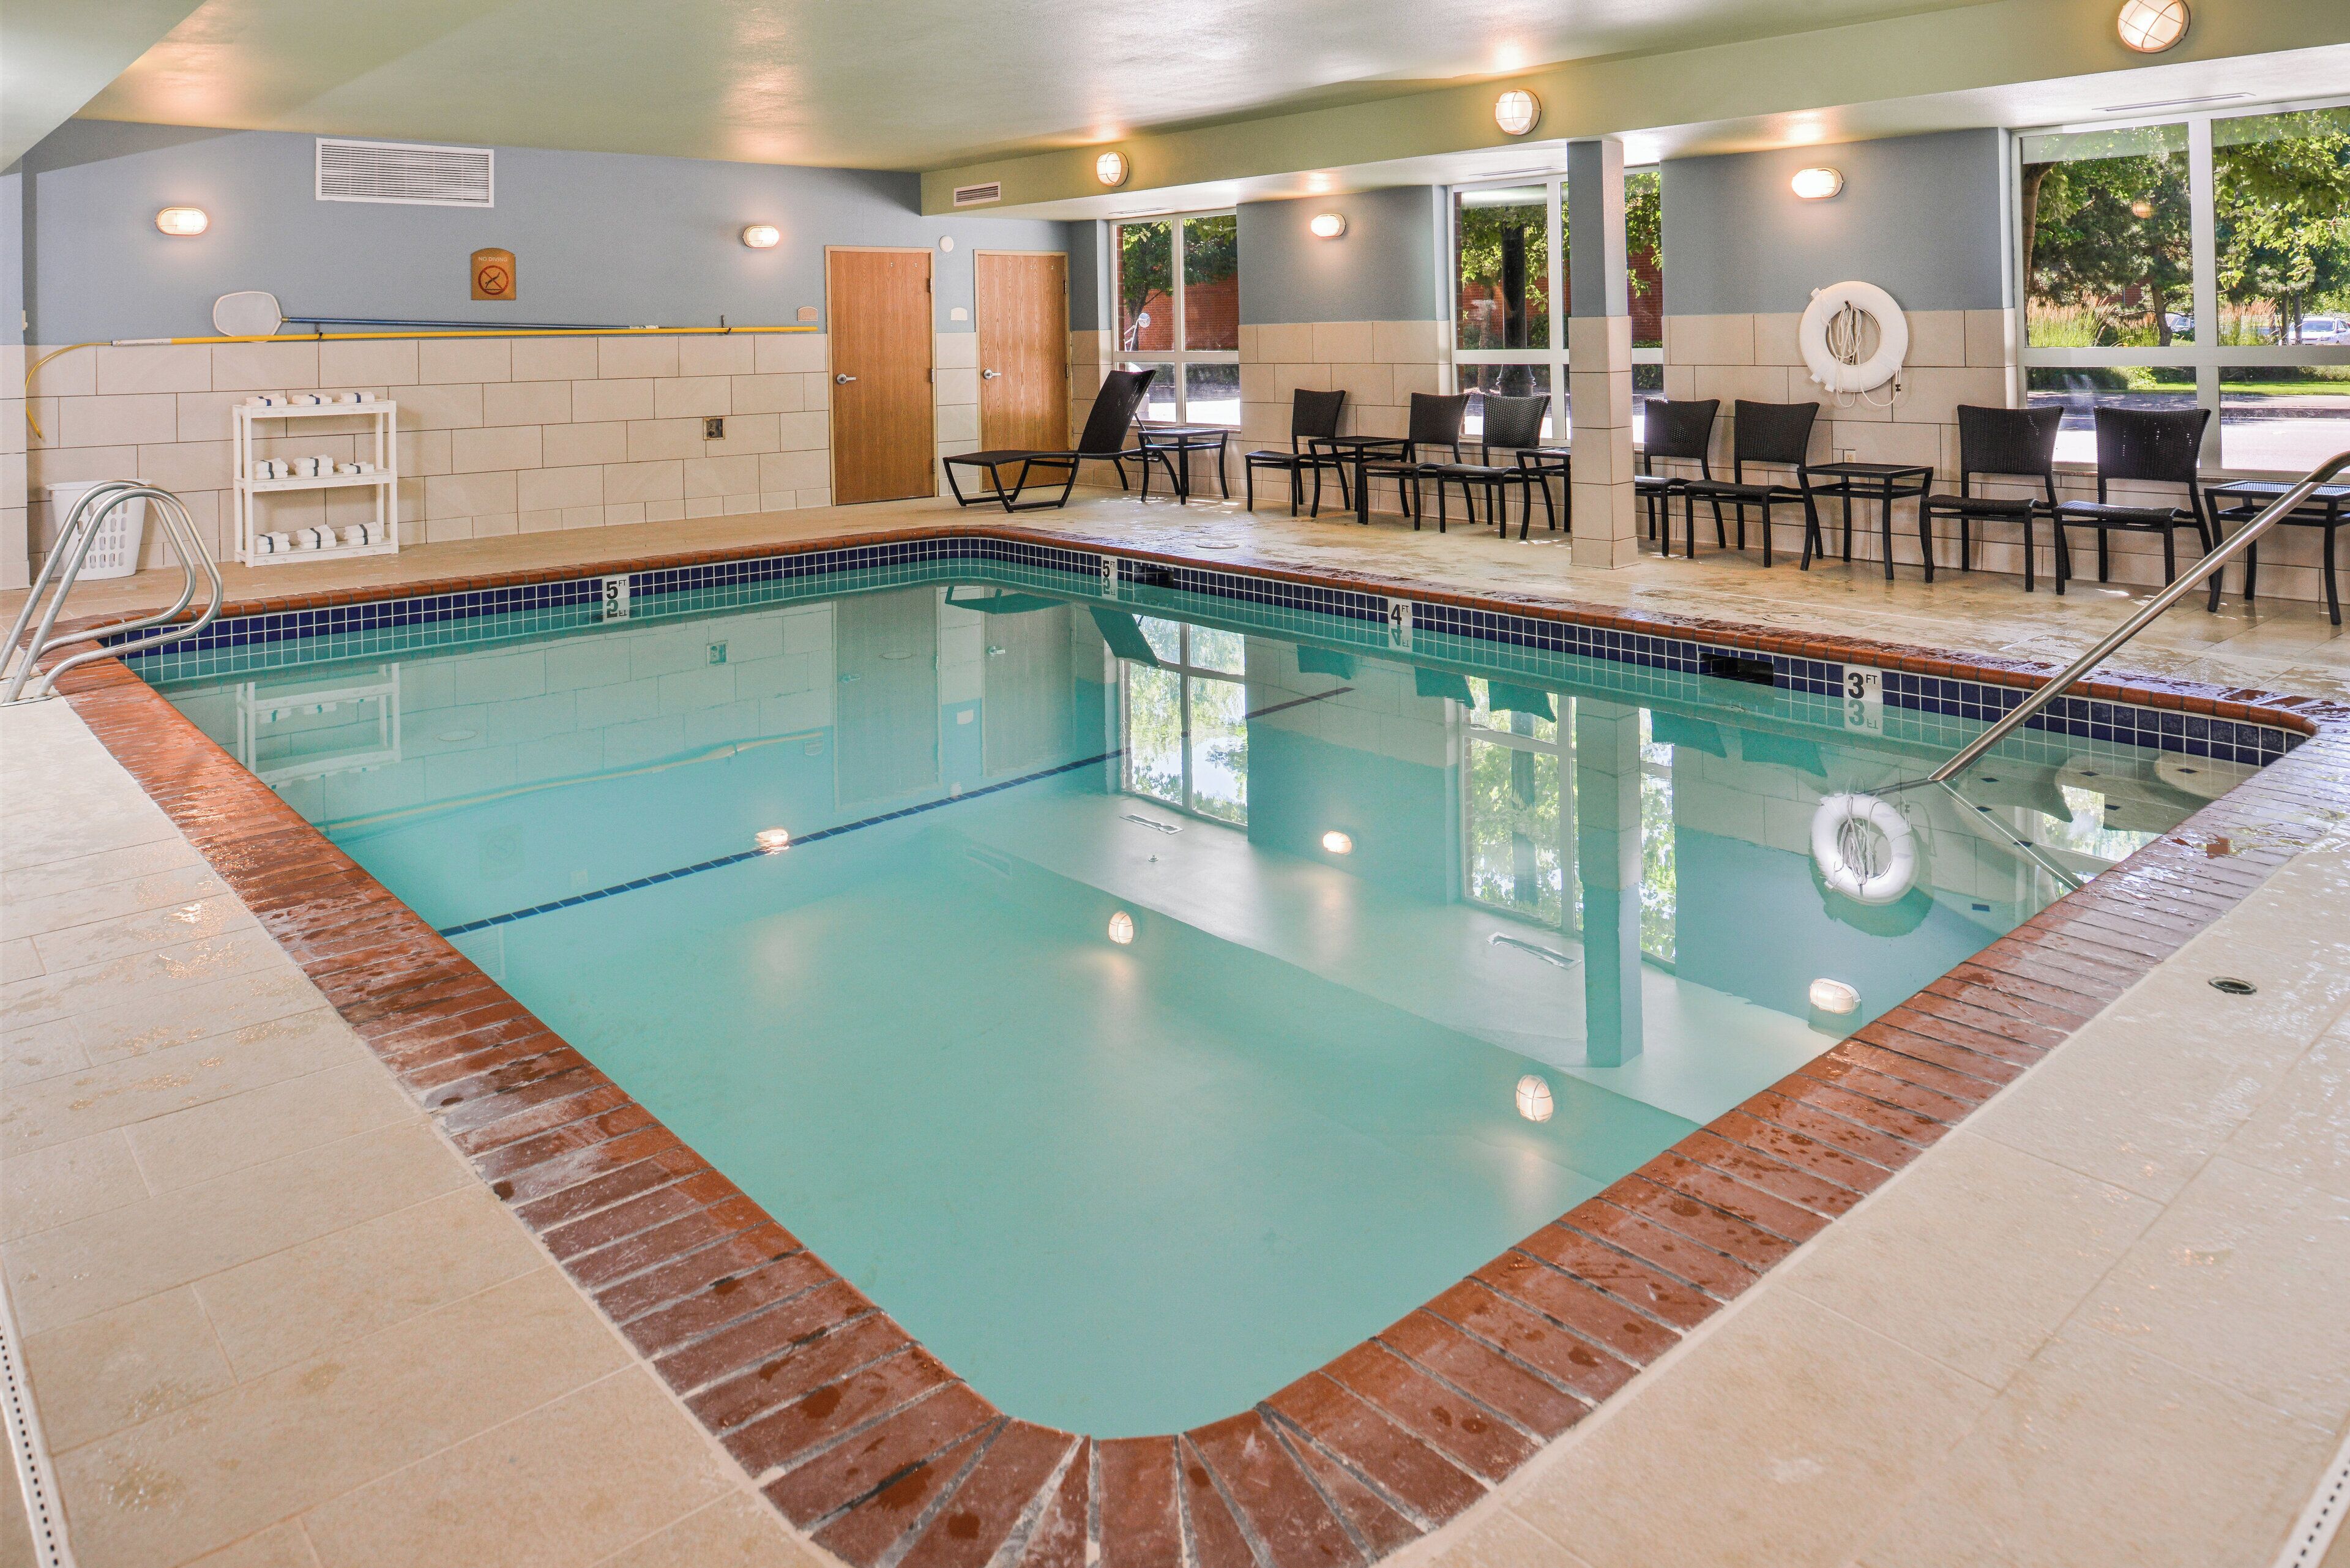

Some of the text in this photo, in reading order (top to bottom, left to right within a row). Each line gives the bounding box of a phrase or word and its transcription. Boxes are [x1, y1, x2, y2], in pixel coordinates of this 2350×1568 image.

[1103, 560, 1110, 578] 5
[606, 580, 619, 600] 5
[1390, 604, 1409, 625] 4 FT
[1848, 672, 1878, 700] 3 FT
